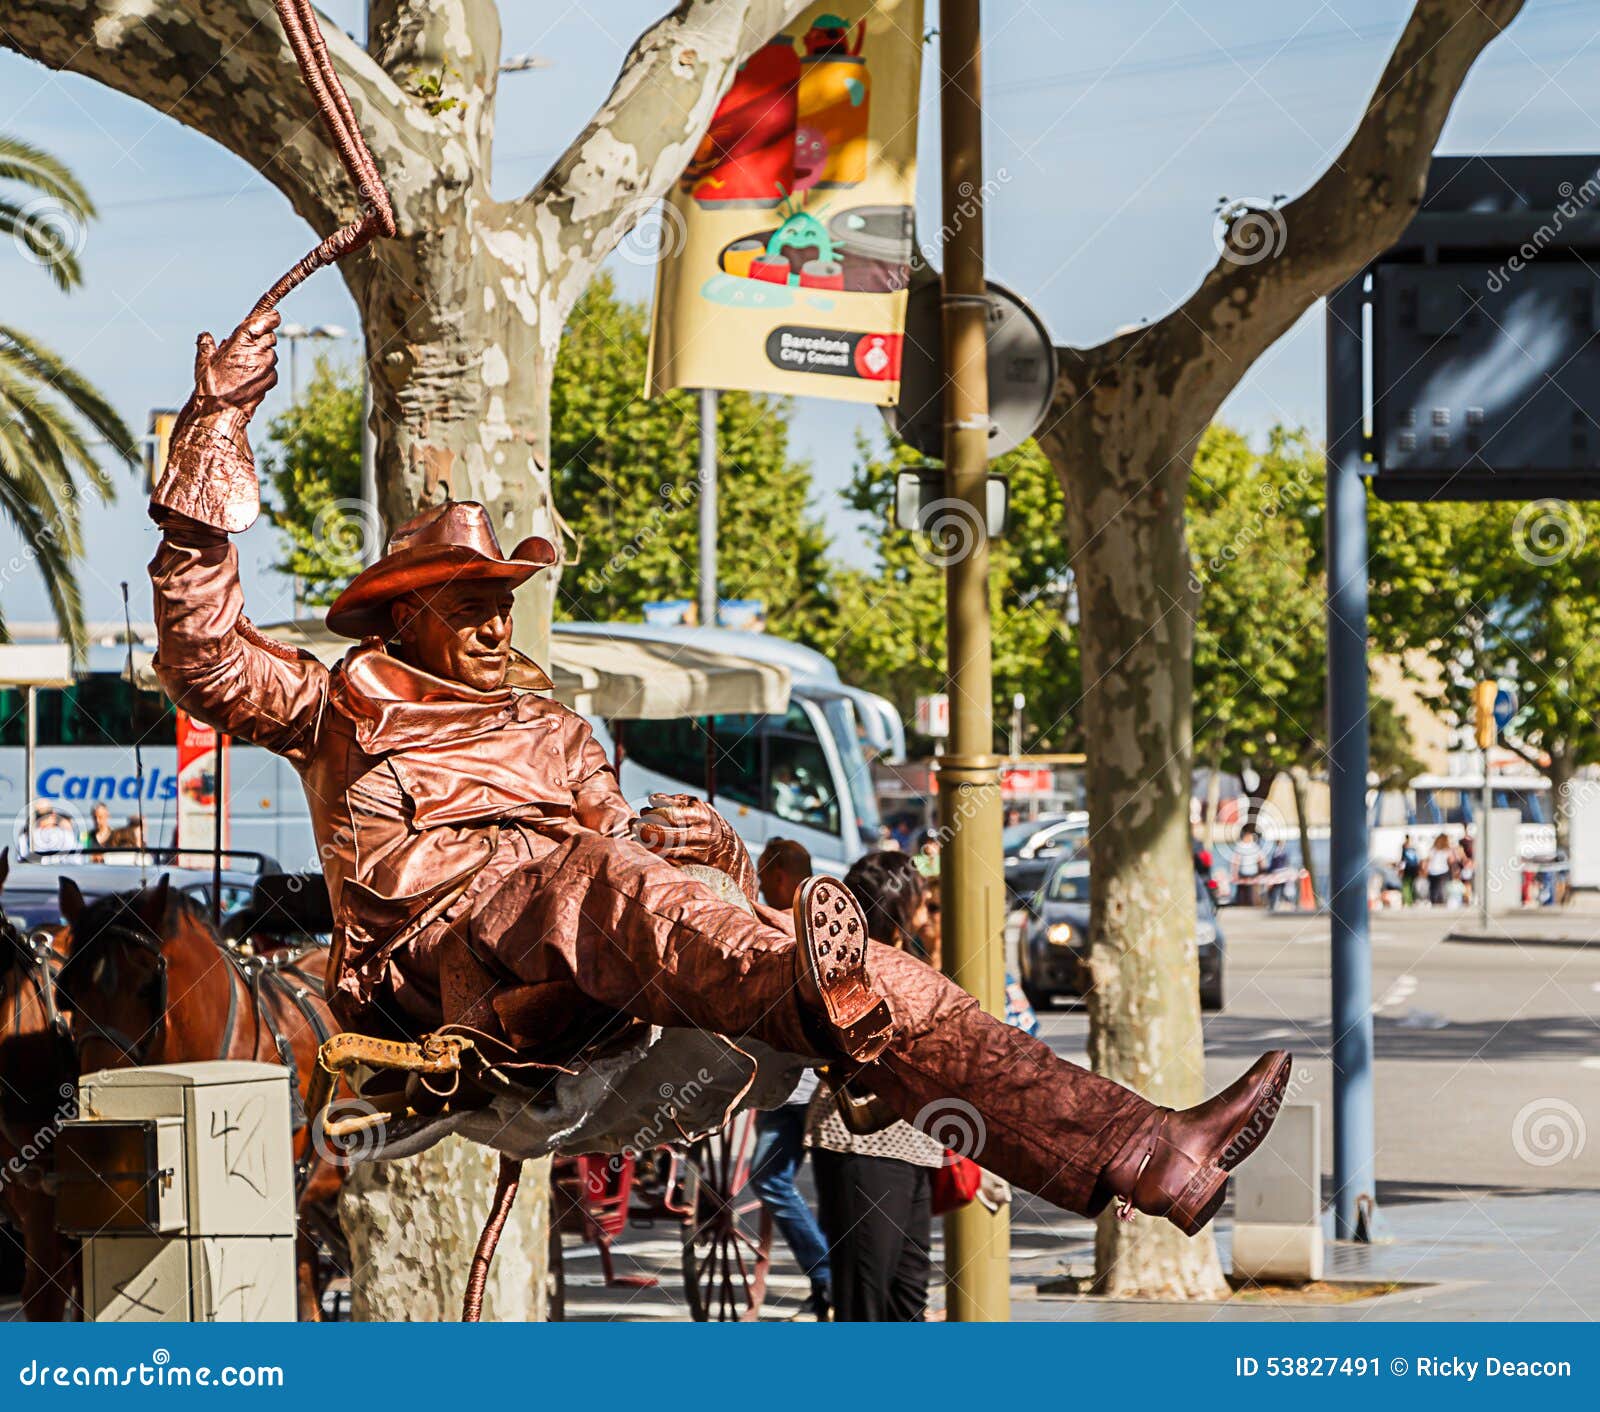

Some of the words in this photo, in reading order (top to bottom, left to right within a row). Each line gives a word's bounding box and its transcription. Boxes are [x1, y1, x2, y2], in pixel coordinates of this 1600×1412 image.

[781, 333, 850, 353] Barcelona
[781, 348, 806, 365] City
[807, 350, 849, 366] Council
[36, 768, 177, 800] Canals
